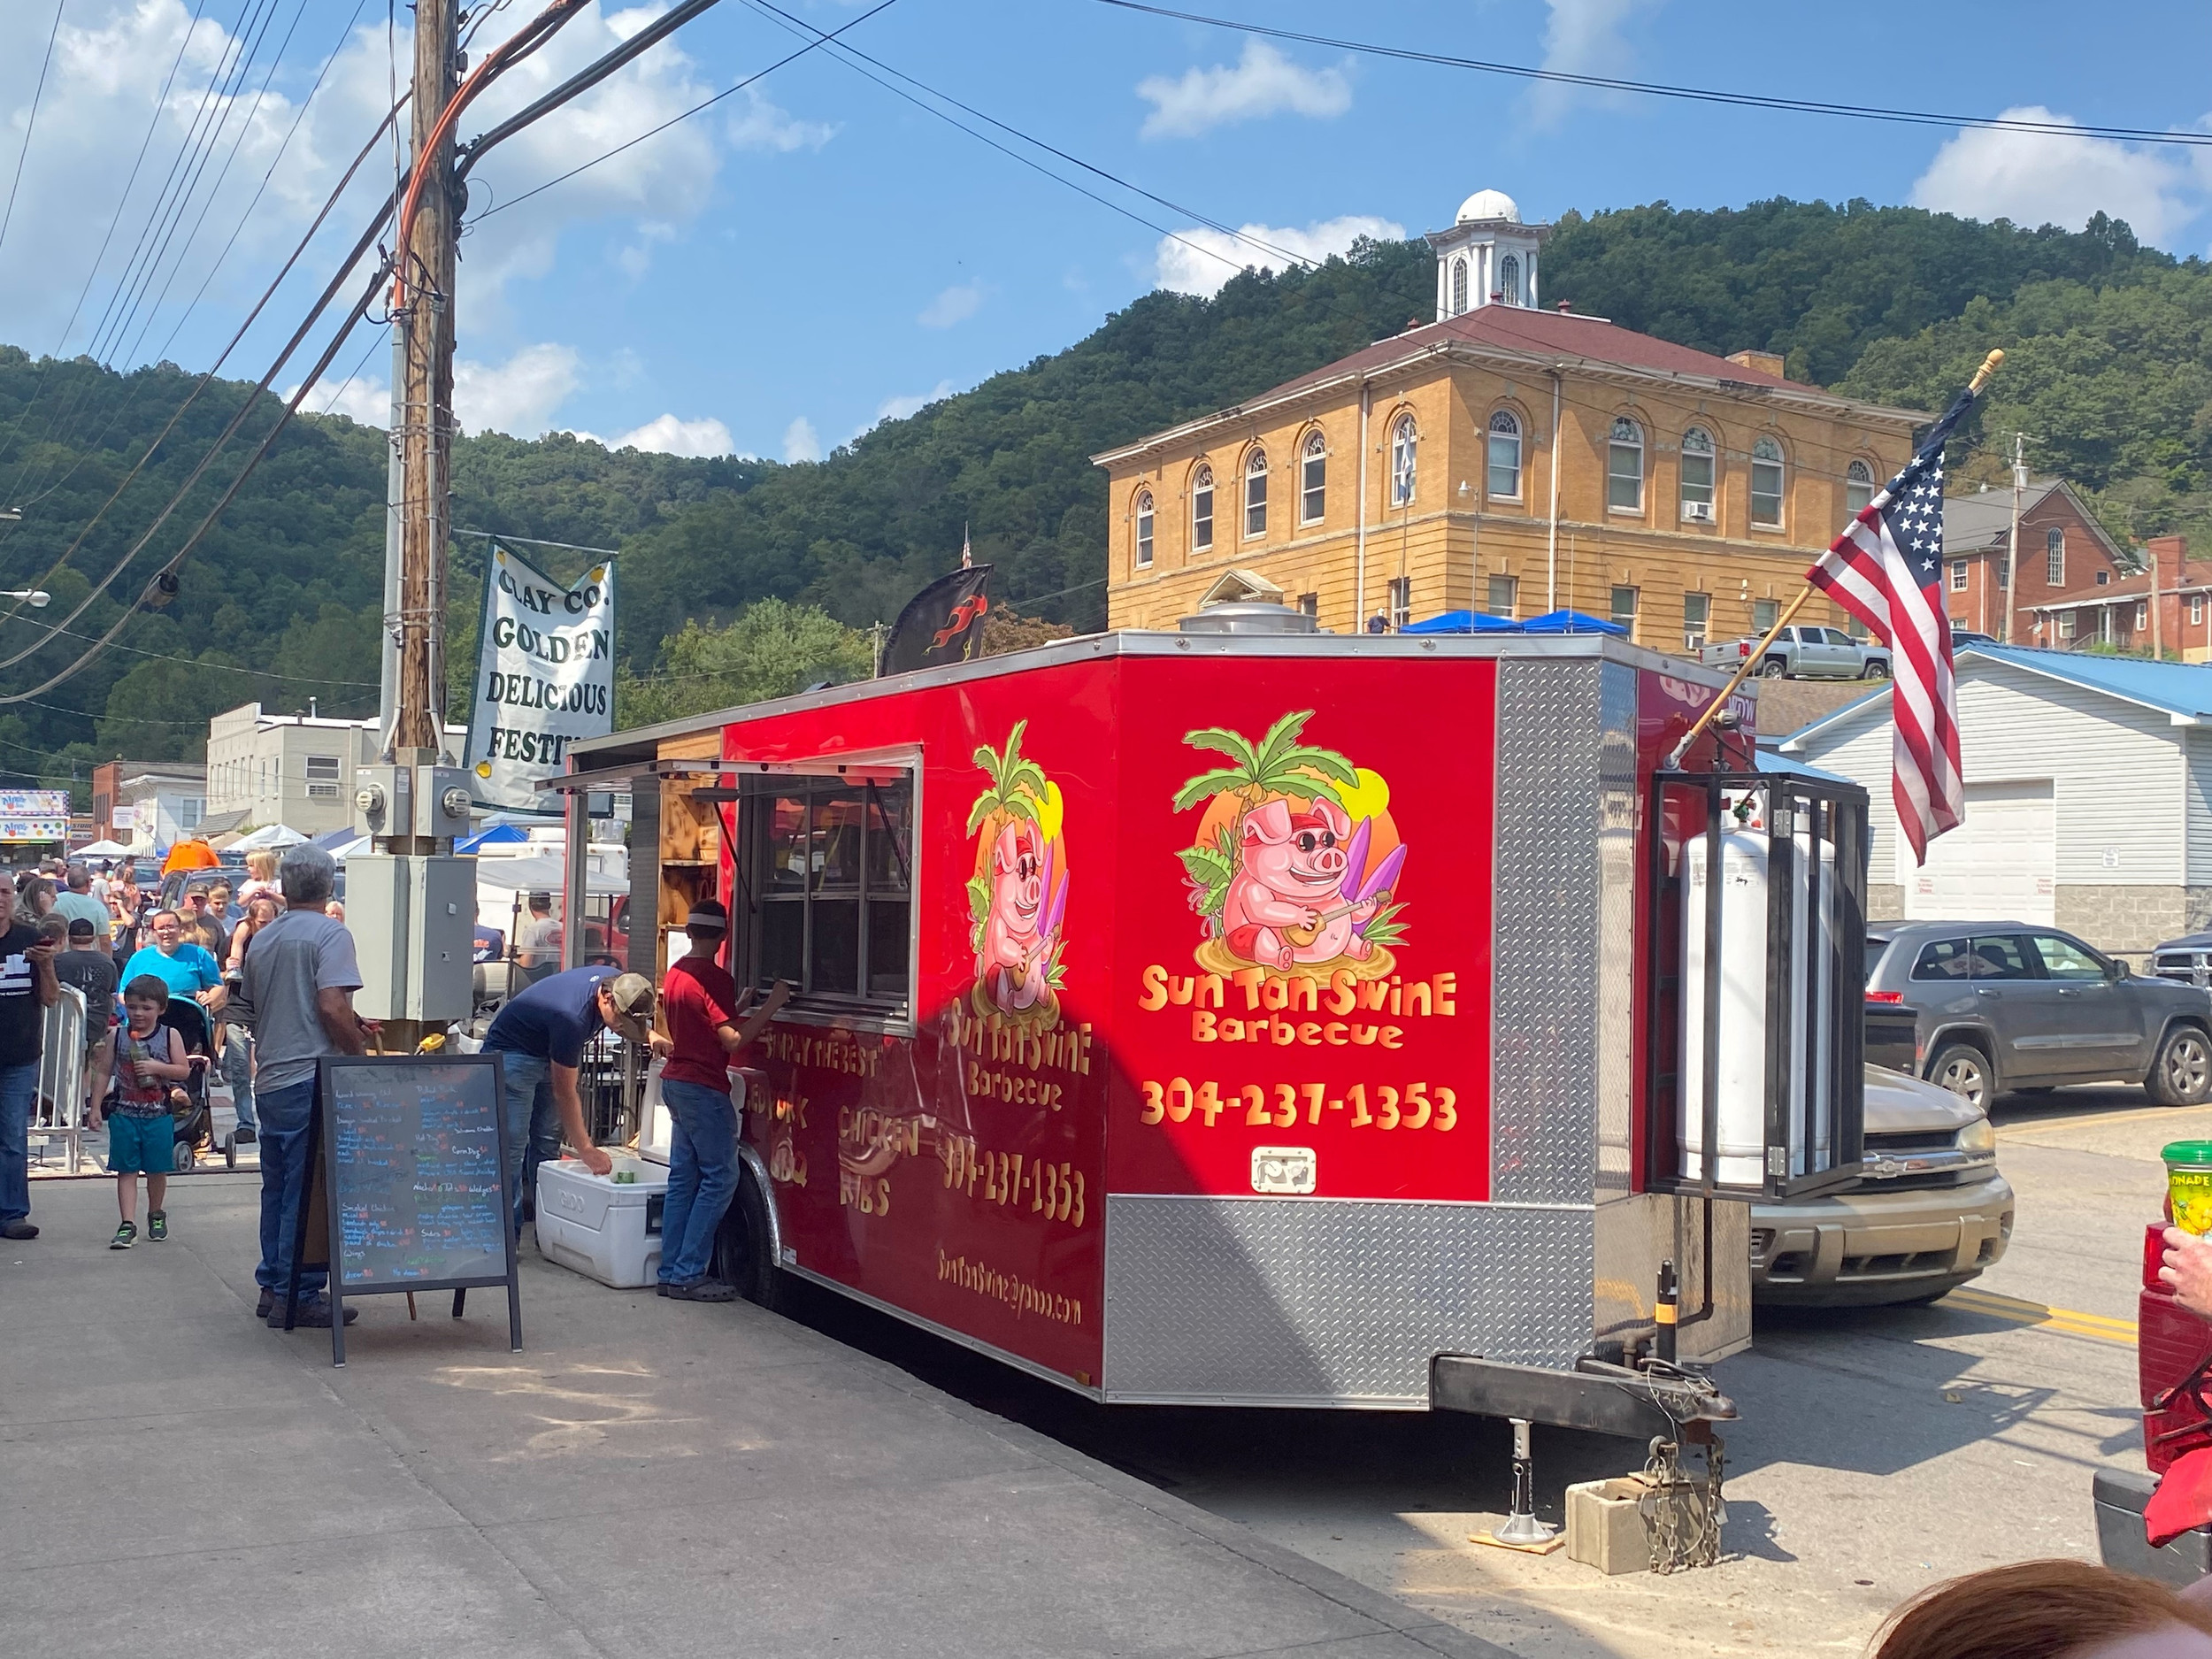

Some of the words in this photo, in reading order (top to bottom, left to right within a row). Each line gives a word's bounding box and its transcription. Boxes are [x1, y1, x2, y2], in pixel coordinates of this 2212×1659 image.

[498, 569, 557, 615] CLAY
[564, 585, 609, 615] CO.
[493, 616, 610, 664] GOLDEN
[487, 671, 607, 715] DELICIOUS
[487, 726, 587, 766] FESTI
[1138, 964, 1224, 1011] Sun
[1232, 966, 1317, 1012] Tan
[947, 996, 984, 1056] Sun
[986, 1011, 1025, 1065] Tan
[1191, 1010, 1405, 1049] Barbecue
[814, 1040, 839, 1070] THE
[968, 1060, 1063, 1112] Barbecue
[1140, 1076, 1458, 1132] 304-237-1353
[839, 1104, 919, 1157] CHICKEN
[840, 1171, 891, 1217] RIBS
[943, 1137, 1086, 1228] 304-237-1353
